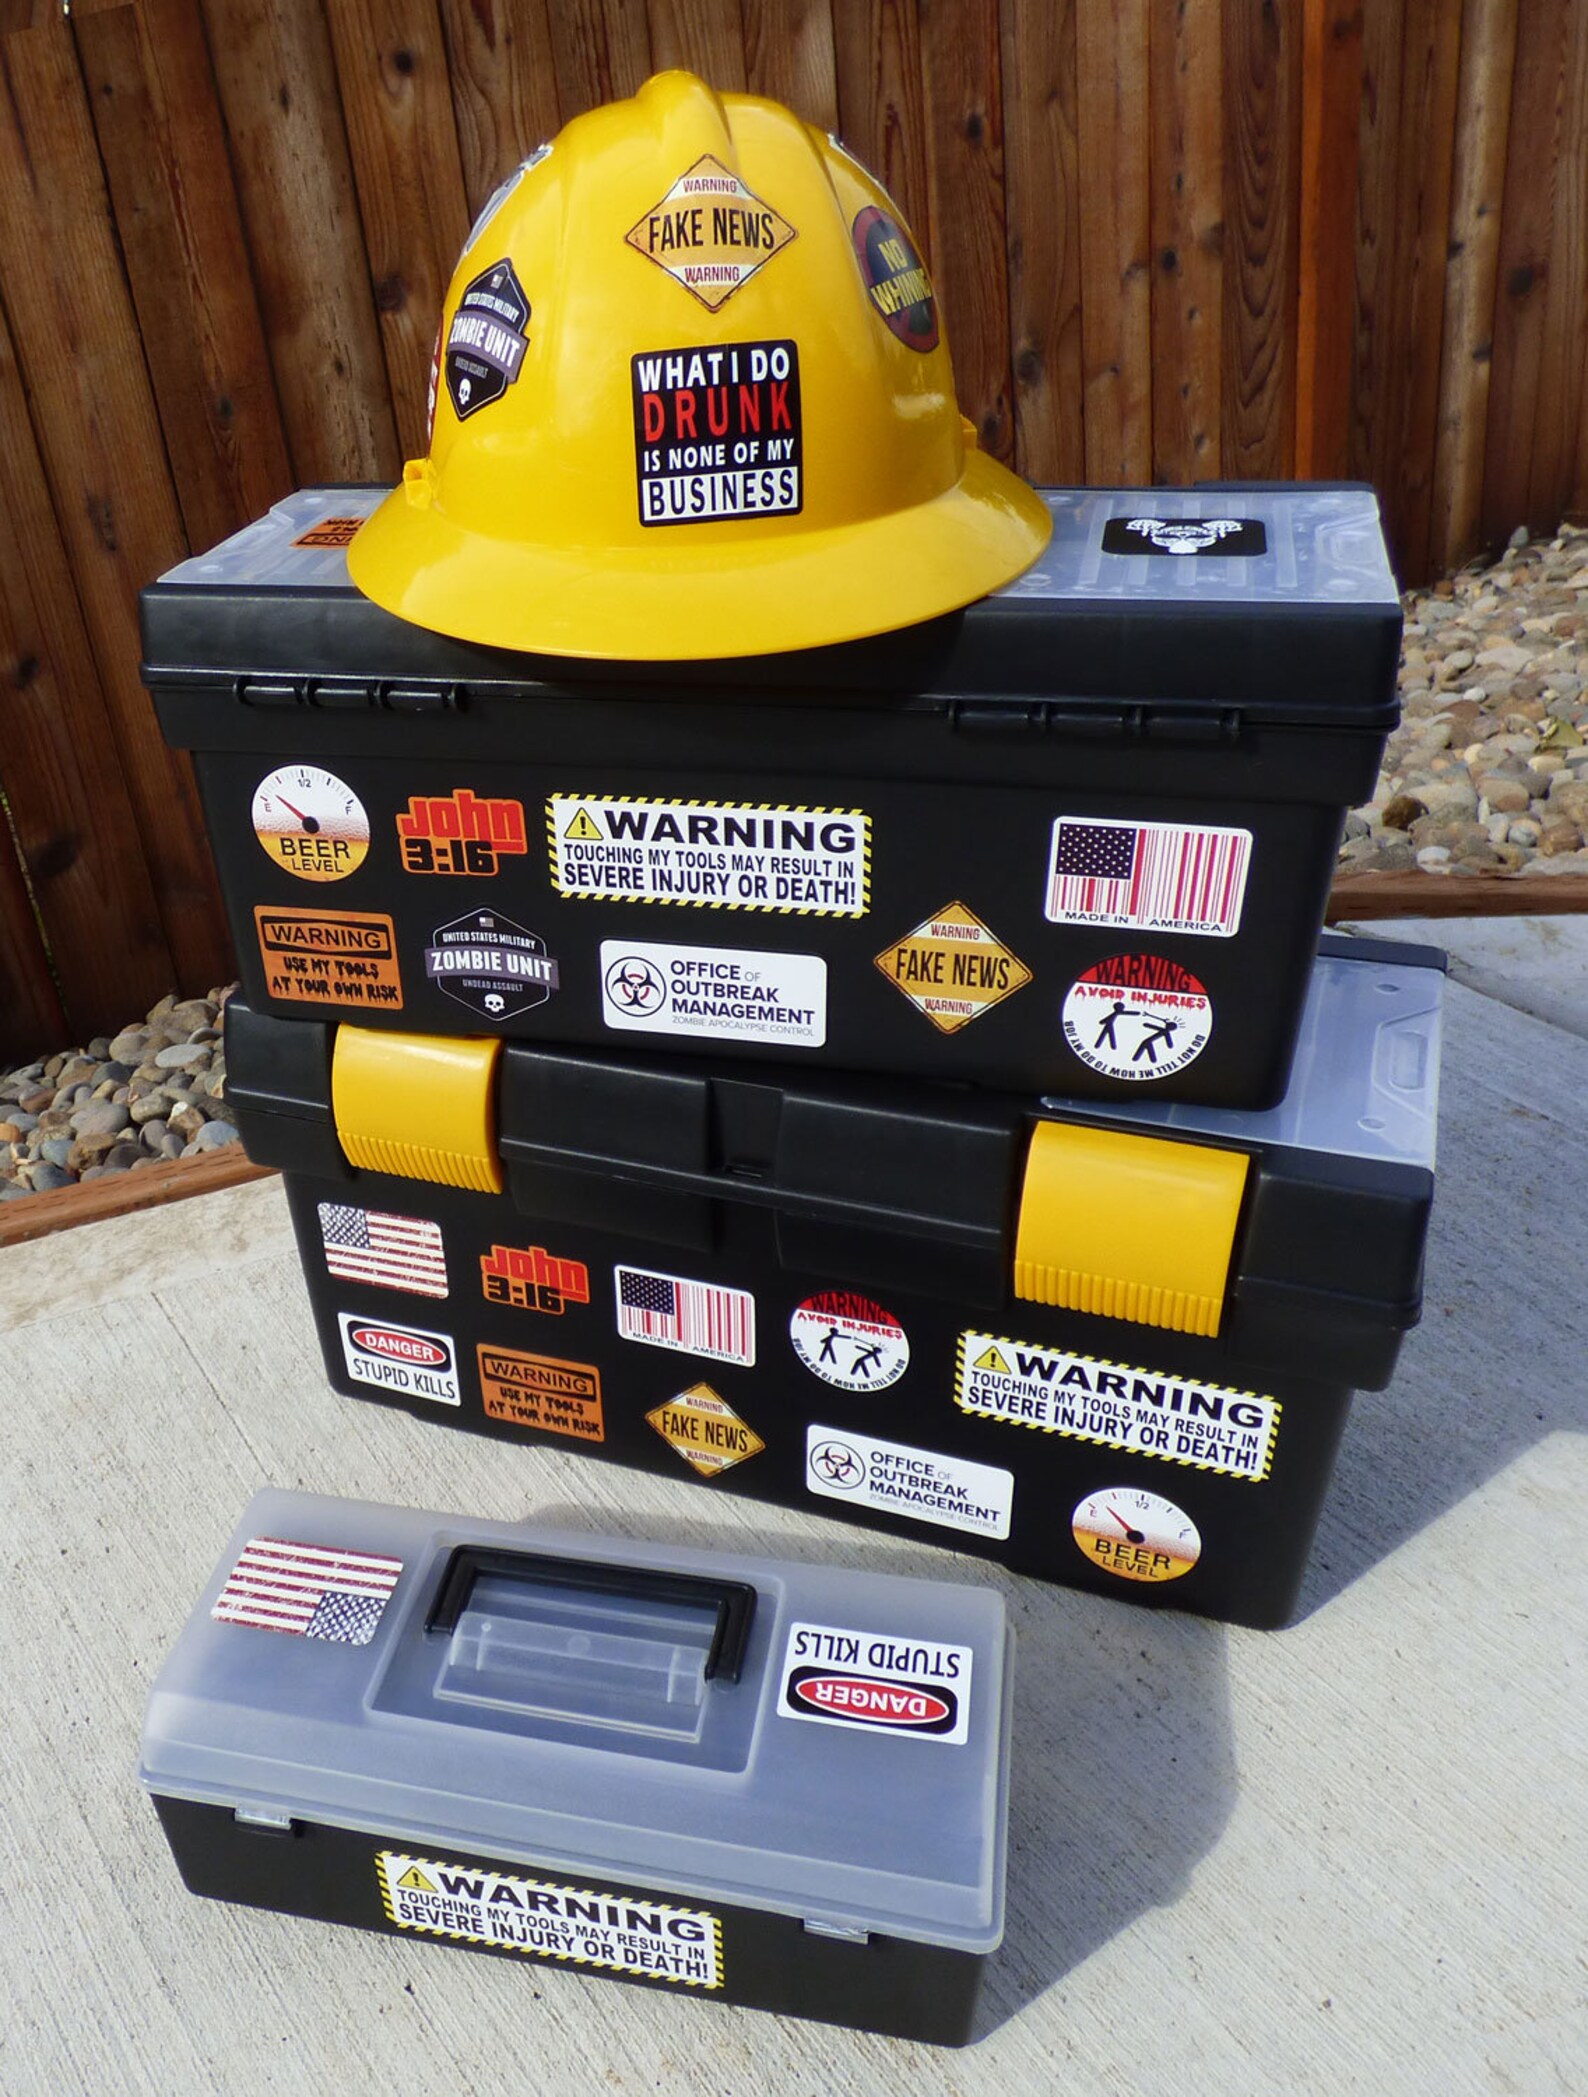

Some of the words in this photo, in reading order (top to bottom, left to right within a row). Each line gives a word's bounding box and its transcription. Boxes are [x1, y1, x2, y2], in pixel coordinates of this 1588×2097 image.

[683, 178, 738, 193] WARNING
[649, 208, 704, 253] FAKE
[713, 207, 775, 250] NEWS
[878, 238, 908, 274] NO
[684, 266, 740, 283] WARNING
[449, 316, 488, 348] ZOMBIE
[484, 325, 520, 368] UNIT
[638, 352, 723, 392] WHAT
[731, 351, 739, 383] I
[751, 347, 790, 382] DO
[643, 381, 792, 443] DRUNK
[644, 450, 661, 472] IS
[669, 444, 725, 470] NONE
[734, 441, 760, 464] OF
[767, 438, 794, 461] MY
[649, 469, 794, 516] BUSINESS
[297, 778, 311, 788] 1/2
[264, 803, 272, 813] E
[399, 790, 526, 853] John
[604, 810, 856, 853] WARNING
[280, 837, 350, 859] BEER
[404, 838, 496, 873] 3:16
[564, 844, 643, 864] TOUCHING
[649, 849, 671, 866] MY
[675, 850, 726, 870] TOOLS
[732, 854, 765, 873] MAY
[771, 856, 832, 877] RESULT
[838, 860, 854, 879] IN
[291, 858, 344, 873] LEVEL
[564, 862, 644, 890] SEVERE
[651, 868, 731, 896] INJURY
[738, 874, 768, 899] OR
[776, 877, 856, 905] DEATH!
[931, 923, 980, 940] WARNING
[1064, 911, 1110, 923] MADE
[1114, 915, 1129, 924] IN
[1149, 918, 1222, 932] AMERICA
[270, 925, 381, 949] WARNING
[442, 932, 469, 943] UNITED
[470, 932, 498, 943] STATES
[498, 933, 536, 950] MILITARY
[283, 956, 307, 972] USE
[311, 959, 330, 976] MY
[336, 961, 379, 978] TOOLS
[431, 950, 502, 971] ZOMBIE
[506, 953, 552, 980] UNIT
[670, 960, 741, 980] OFFICE
[744, 971, 761, 982] OF
[896, 948, 946, 984] FAKE
[952, 953, 1010, 990] NEWS
[1096, 954, 1191, 991] WARNING
[272, 975, 292, 992] AT
[296, 978, 331, 996] YOUR
[334, 981, 363, 998] OWN
[367, 984, 399, 1002] RISK
[492, 980, 524, 992] ASSAULT
[670, 979, 779, 1003] OUTBREAK
[1074, 985, 1125, 999] AVOID
[1131, 991, 1206, 1010] INJURIES
[671, 998, 815, 1025] MANAGEMENT
[925, 998, 973, 1014] WARNING
[672, 1015, 706, 1026] ZOMBIE
[708, 1018, 768, 1033] APOCALYPSE
[769, 1024, 814, 1037] CONTROL
[1195, 1034, 1206, 1048] DO
[1094, 1060, 1108, 1072] TO
[1155, 1061, 1179, 1076] TELL
[1177, 1047, 1197, 1065] NOT
[1109, 1067, 1136, 1079] HOW
[1139, 1069, 1154, 1078] ME
[483, 1247, 589, 1302] John
[486, 1274, 562, 1313] 3:16
[812, 1290, 889, 1324] WARNING
[797, 1312, 837, 1325] AVOID
[842, 1320, 902, 1339] INJURIES
[365, 1333, 434, 1361] DANGER
[632, 1332, 665, 1344] MADE
[667, 1339, 678, 1347] IN
[692, 1346, 744, 1362] AMERICA
[353, 1358, 409, 1387] STUPID
[414, 1373, 456, 1399] KILLS
[491, 1361, 588, 1393] WARNING
[1015, 1351, 1264, 1429] WARNING
[500, 1386, 521, 1402] USE
[525, 1392, 541, 1407] MY
[545, 1396, 584, 1416] TOOLS
[686, 1397, 723, 1413] WARNING
[971, 1370, 1049, 1400] TOUCHING
[1053, 1390, 1076, 1406] MY
[1081, 1395, 1131, 1420] TOOLS
[1135, 1409, 1170, 1429] MAY
[1175, 1418, 1237, 1444] RESULT
[1241, 1434, 1259, 1450] IN
[489, 1400, 505, 1414] AT
[510, 1405, 540, 1422] YOUR
[543, 1412, 569, 1428] OWN
[572, 1418, 600, 1437] RISK
[662, 1410, 699, 1441] FAKE
[705, 1421, 748, 1453] NEWS
[968, 1386, 1047, 1420] SEVERE
[1053, 1406, 1133, 1441] INJURY
[1139, 1426, 1169, 1450] OR
[1176, 1435, 1259, 1471] DEATH!
[871, 1451, 935, 1476] OFFICE
[938, 1471, 953, 1480] OF
[870, 1466, 969, 1500] OUTBREAK
[869, 1480, 1001, 1522] MANAGEMENT
[1135, 1500, 1150, 1510] 1/2
[1095, 1538, 1171, 1570] BEER
[1102, 1556, 1158, 1578] LEVEL
[794, 1631, 860, 1664] KILLS
[868, 1643, 960, 1678] STUPID
[815, 1682, 927, 1717] DANGER
[437, 1872, 706, 1942] WARNING
[397, 1889, 482, 1917] TOUCHING
[487, 1906, 511, 1923] MY
[515, 1912, 570, 1935] TOOLS
[576, 1924, 611, 1942] MAY
[617, 1932, 681, 1956] RESULT
[688, 1947, 705, 1961] IN
[399, 1903, 485, 1935] SEVERE
[491, 1921, 577, 1953] INJURY
[583, 1940, 616, 1962] OR
[623, 1947, 709, 1980] DEATH!
